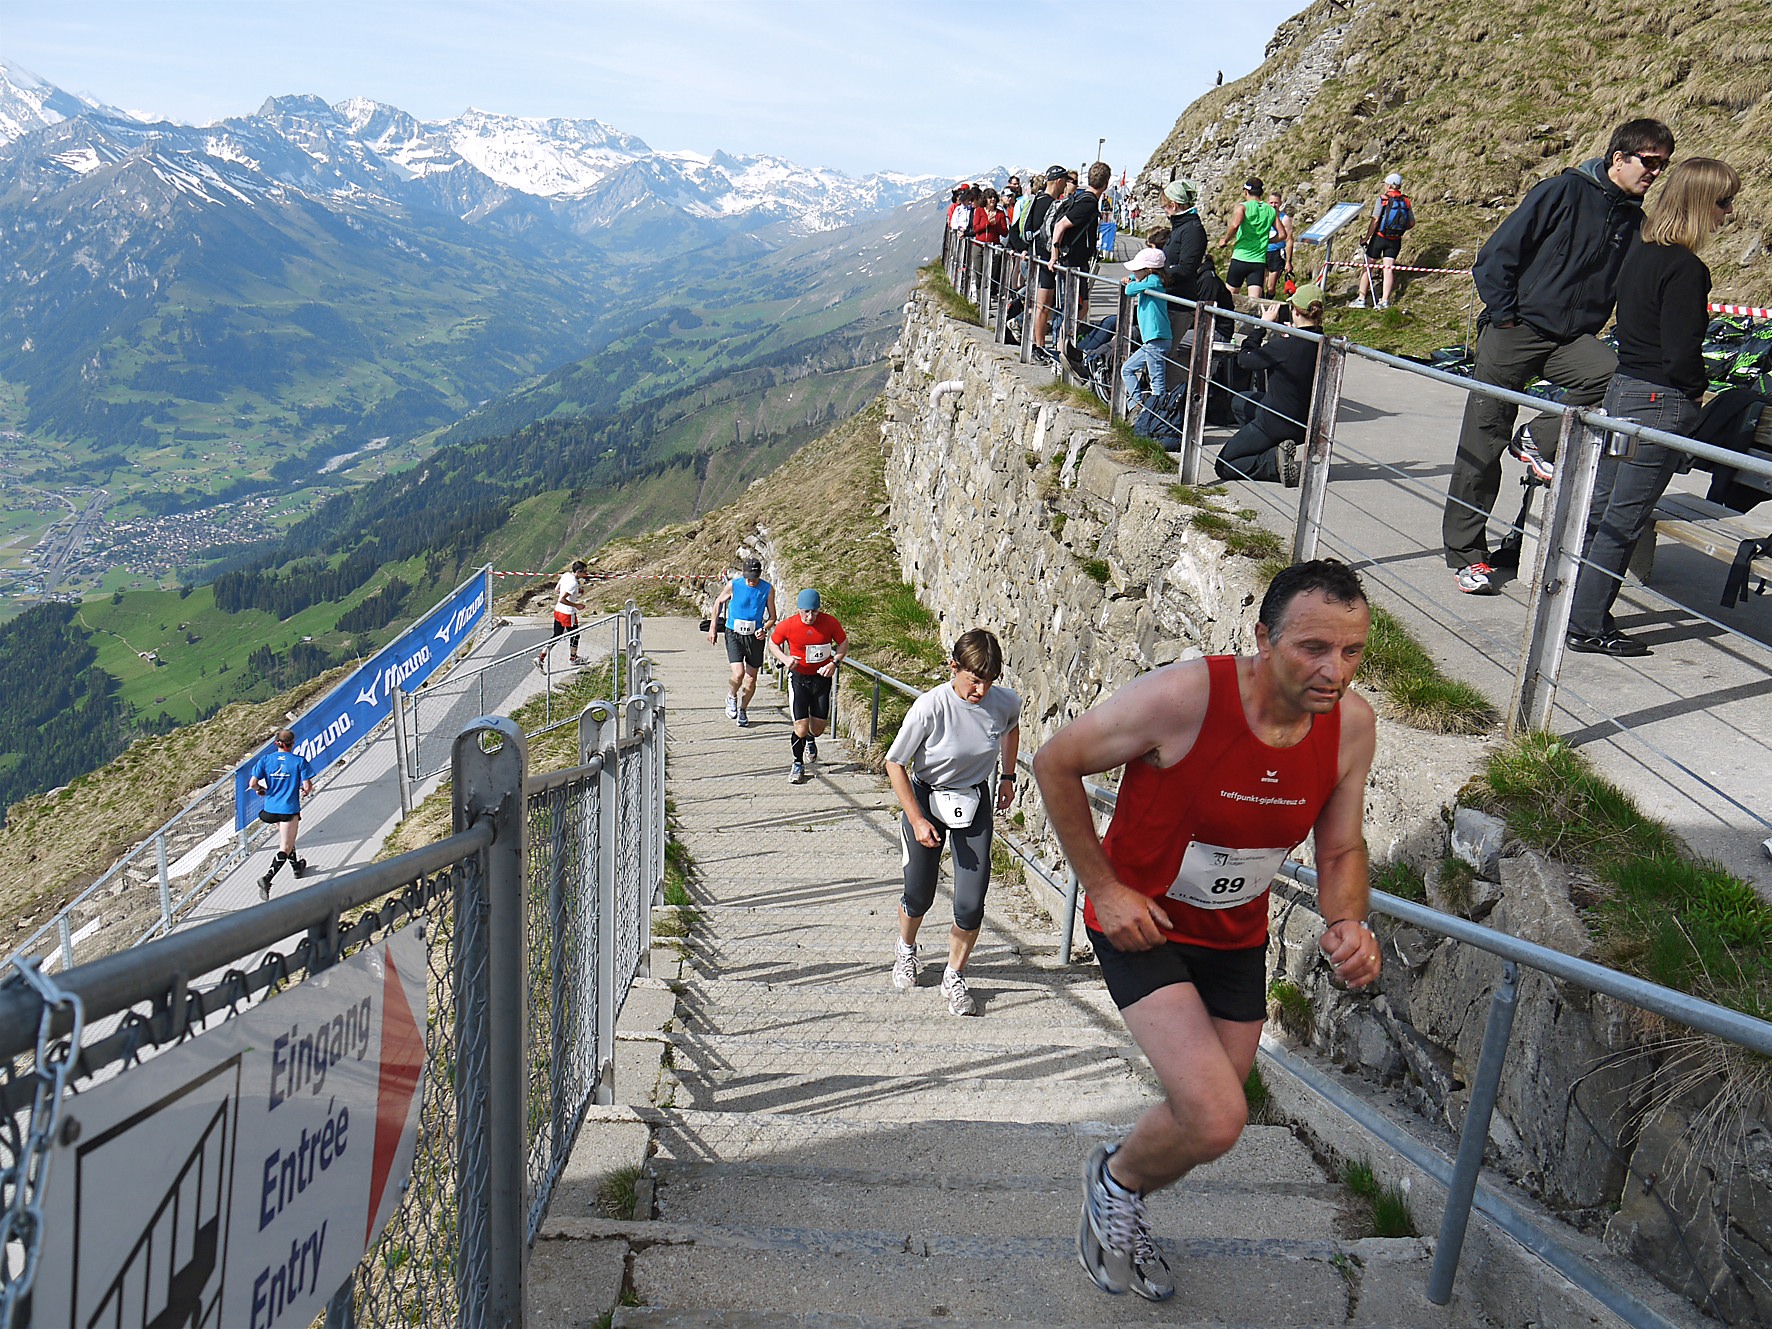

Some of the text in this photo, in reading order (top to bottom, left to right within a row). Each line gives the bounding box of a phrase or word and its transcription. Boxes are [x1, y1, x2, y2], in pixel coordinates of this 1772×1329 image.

[954, 807, 963, 818] 6
[1211, 877, 1246, 895] 89
[269, 995, 371, 1112] Eingang
[259, 1095, 349, 1232] Entrée
[250, 1218, 328, 1329] Entry
